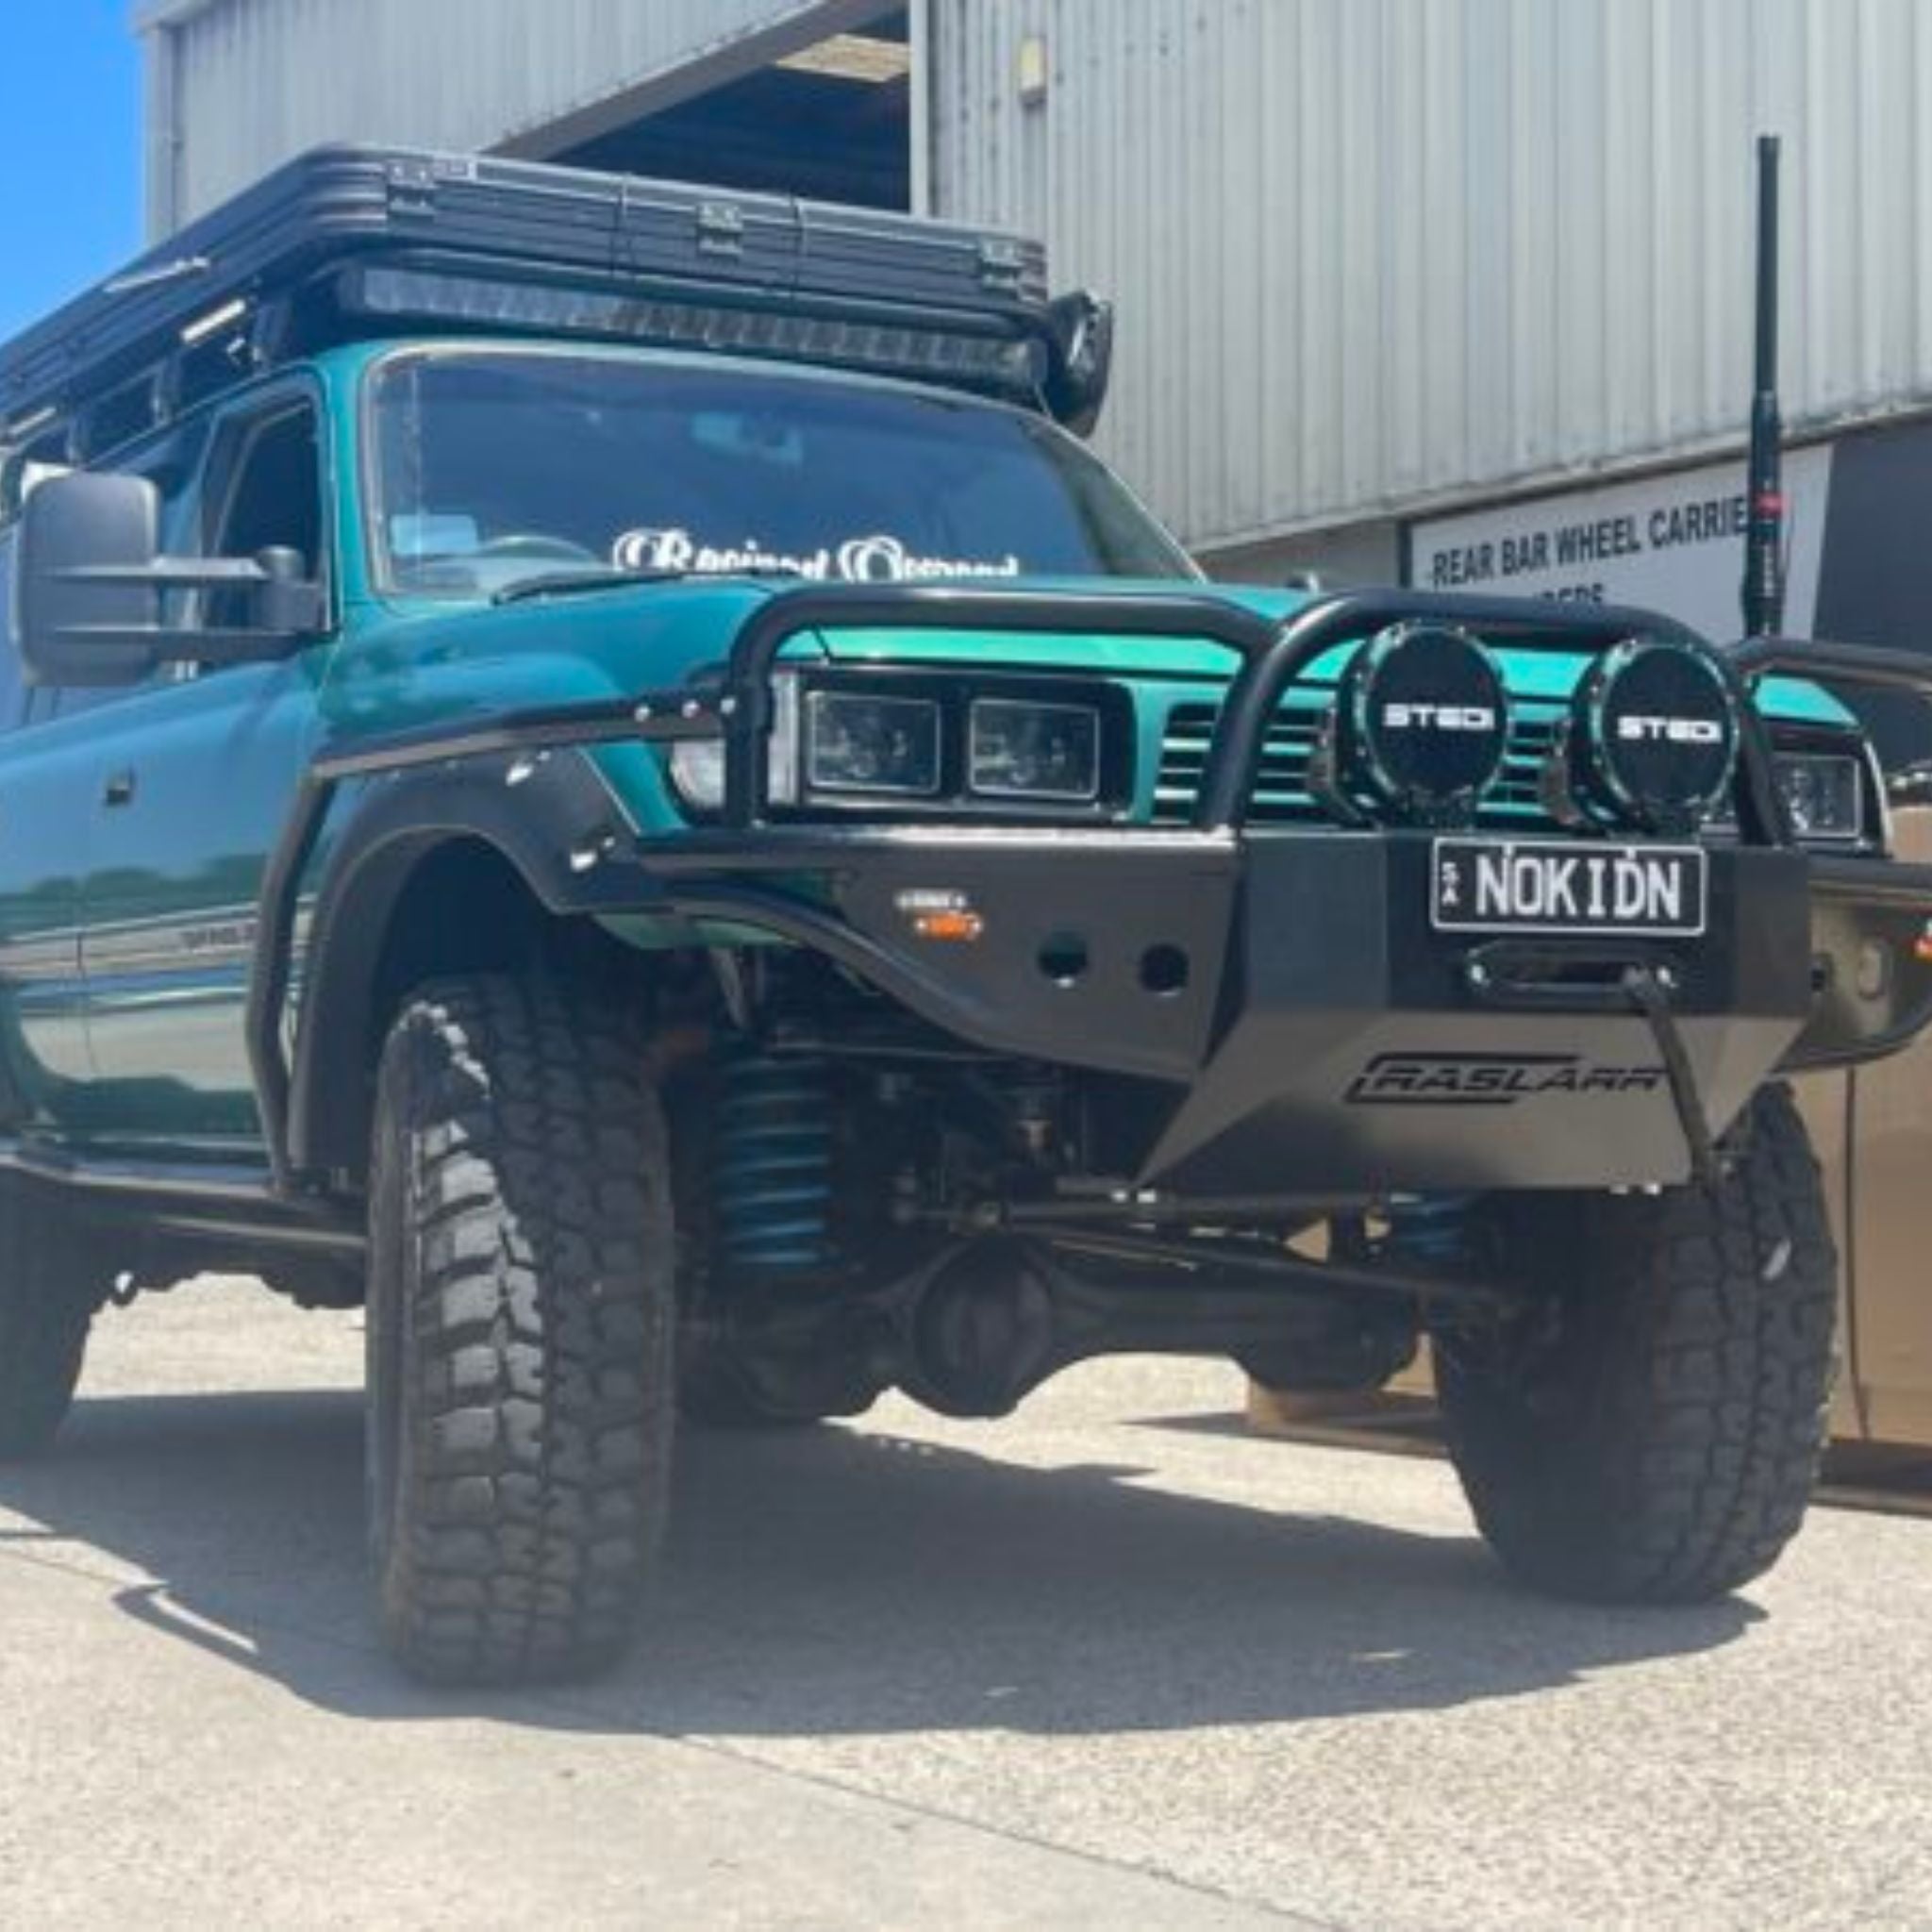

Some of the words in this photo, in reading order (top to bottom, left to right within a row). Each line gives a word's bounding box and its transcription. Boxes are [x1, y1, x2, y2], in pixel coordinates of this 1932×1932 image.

[1432, 541, 1493, 589] REAR
[1502, 532, 1548, 576] BAR
[1557, 515, 1641, 566] WHEEL
[1648, 494, 1751, 549] CARRIE
[1475, 853, 1681, 920] NOKIDN
[1368, 1064, 1671, 1092] RASLARR
